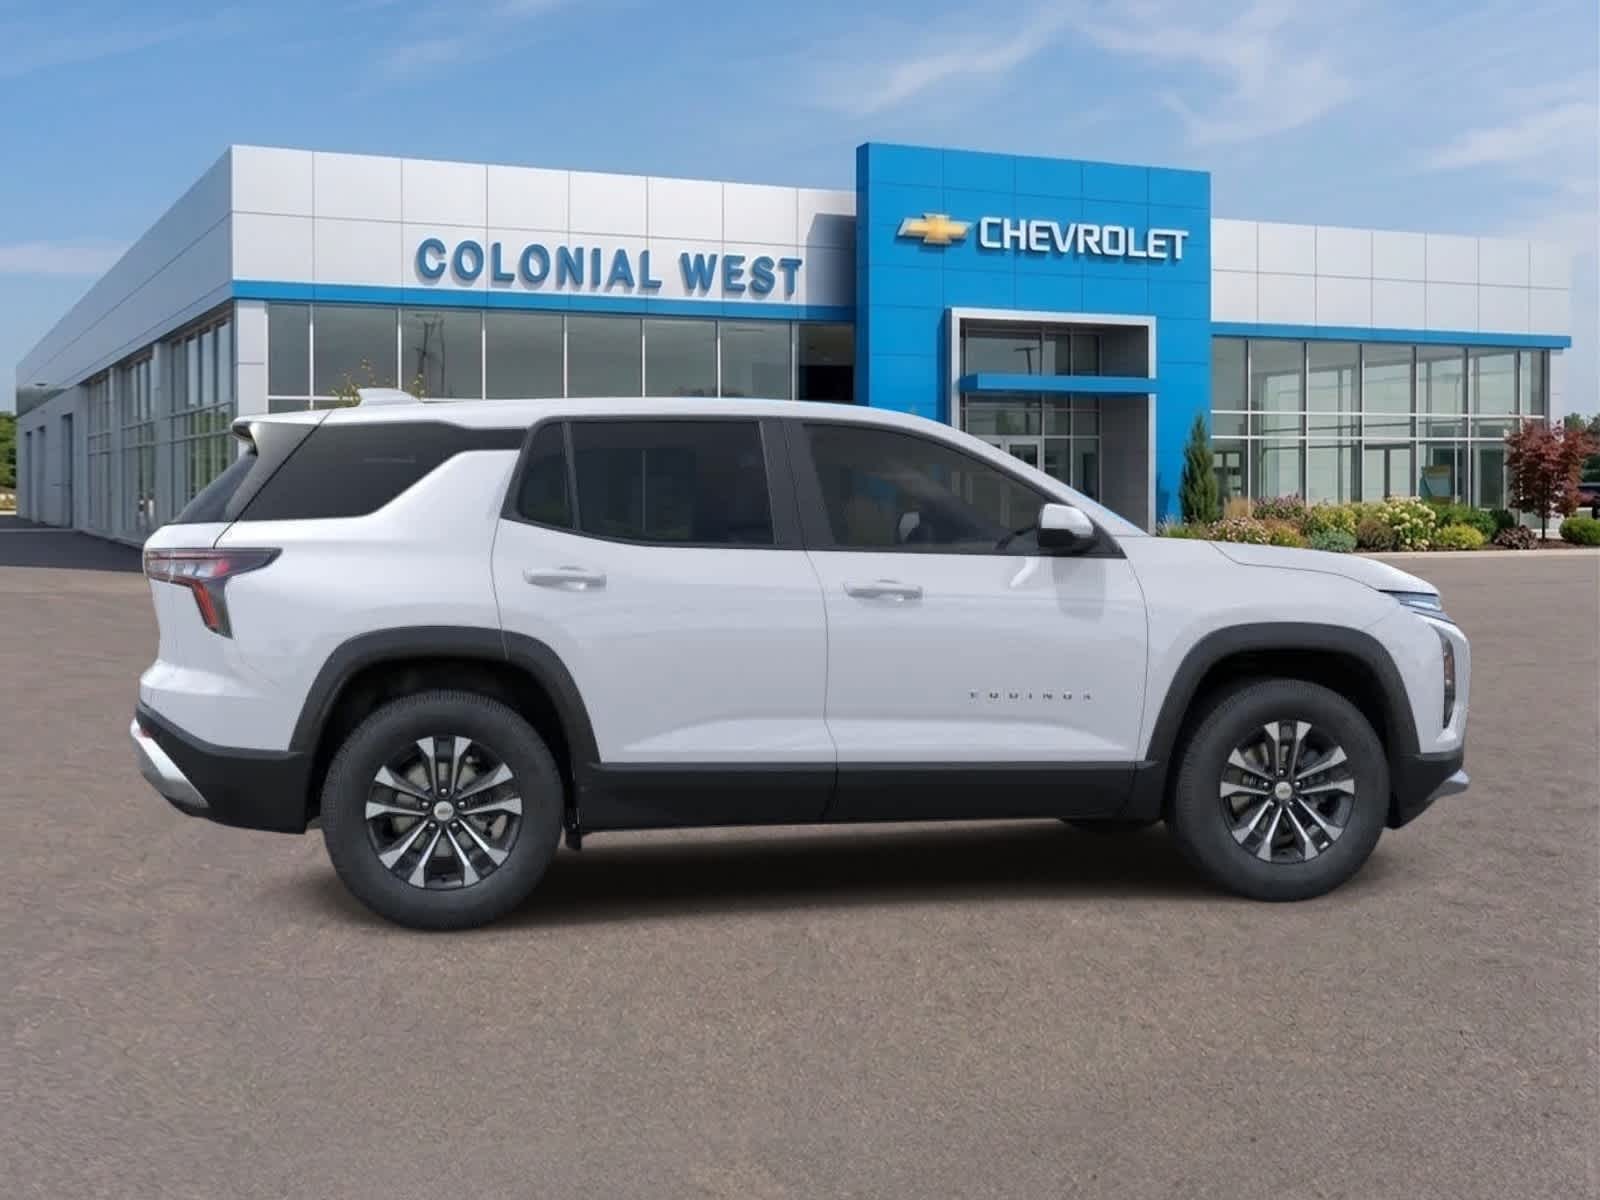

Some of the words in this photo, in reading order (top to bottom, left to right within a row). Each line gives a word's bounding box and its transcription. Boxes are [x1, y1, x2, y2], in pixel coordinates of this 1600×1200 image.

[979, 216, 1190, 262] CHEVROLET
[416, 237, 662, 289] COLONIAL
[681, 252, 803, 294] WEST
